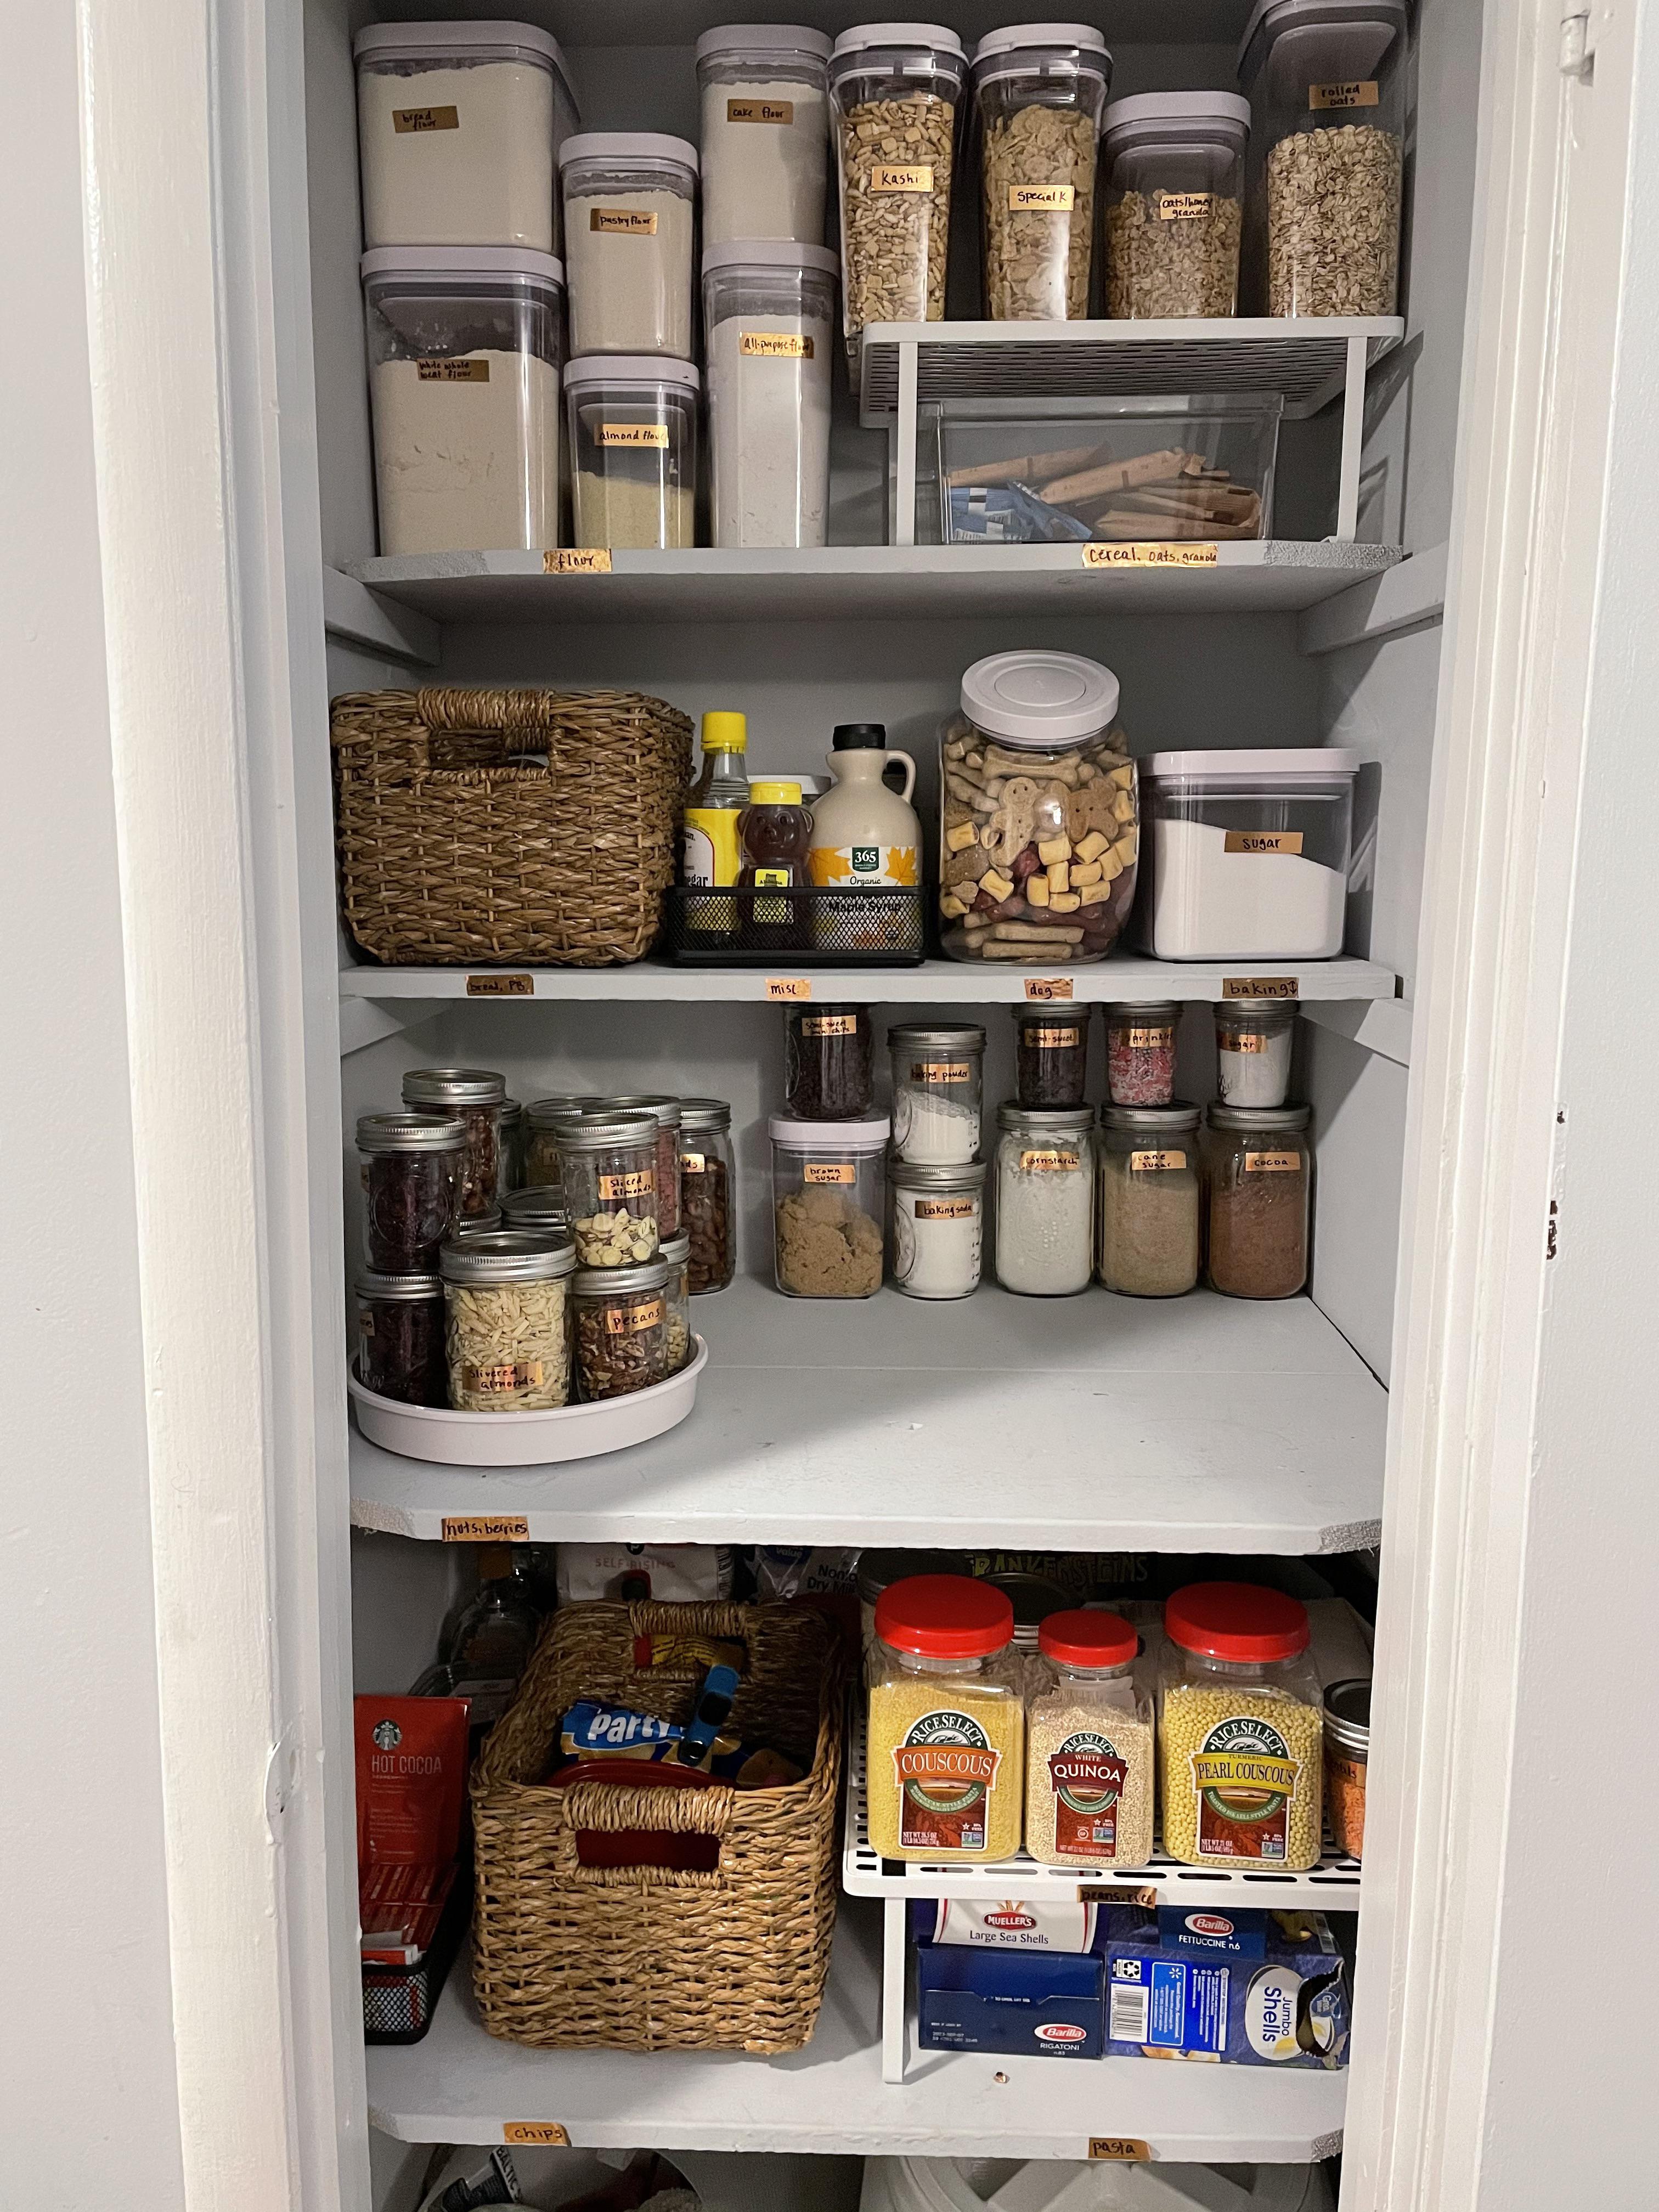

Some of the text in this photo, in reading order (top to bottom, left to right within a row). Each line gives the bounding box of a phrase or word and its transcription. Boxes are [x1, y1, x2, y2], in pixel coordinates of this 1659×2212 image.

[1321, 84, 1360, 98] rolled
[1330, 96, 1355, 105] oats
[403, 111, 431, 123] bread
[733, 109, 755, 117] cake
[882, 171, 918, 185] Kashi
[1059, 191, 1066, 203] K
[600, 216, 629, 227] pastry
[599, 430, 639, 440] almond
[557, 553, 594, 570] flour
[1242, 838, 1282, 851] sugar
[855, 850, 877, 863] 365
[850, 876, 882, 886] Organic
[1030, 983, 1053, 1000] dog
[1230, 983, 1288, 997] baking
[924, 1205, 955, 1217] baking
[481, 1376, 537, 1390] almonds
[911, 1714, 984, 1743] RICESELECT
[1209, 1720, 1284, 1750] RICESELECT
[1063, 1733, 1114, 1754] RICESELECT
[372, 1755, 443, 1775] HOT COCOA
[901, 1752, 993, 1777] COUSCOUS
[1053, 1764, 1121, 1782] QUINOA
[1197, 1762, 1295, 1786] PEARL COUSCOUS
[987, 1915, 1032, 1928] MUELLER'S
[1196, 1918, 1230, 1932] Barilla
[970, 1930, 1049, 1945] Large Sea Shells
[1178, 1934, 1226, 1949] FETTUCCINE
[1262, 1986, 1282, 2042] Shells
[1282, 1996, 1293, 2036] Jumbo
[1046, 2027, 1082, 2038] Barilla
[1040, 2042, 1080, 2051] RIGATONI
[514, 2127, 562, 2141] chips
[1093, 2141, 1136, 2157] pasta
